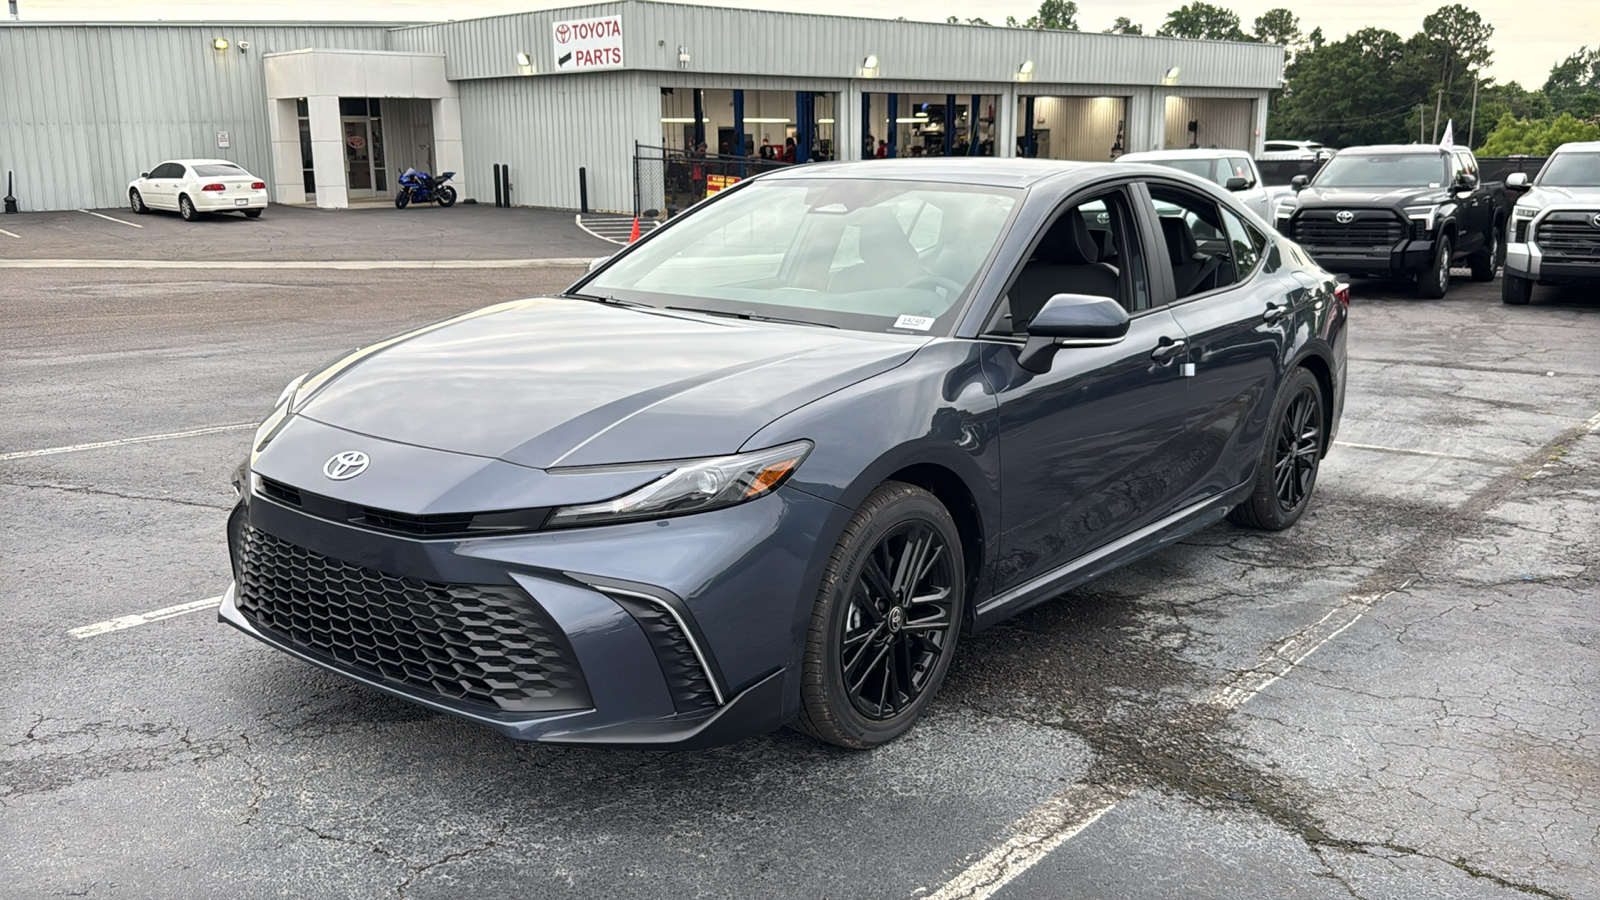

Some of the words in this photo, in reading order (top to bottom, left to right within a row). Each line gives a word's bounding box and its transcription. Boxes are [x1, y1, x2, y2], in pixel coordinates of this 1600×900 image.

[572, 20, 621, 40] TOYOTA
[576, 47, 621, 67] PARTS
[842, 528, 874, 583] Continental
